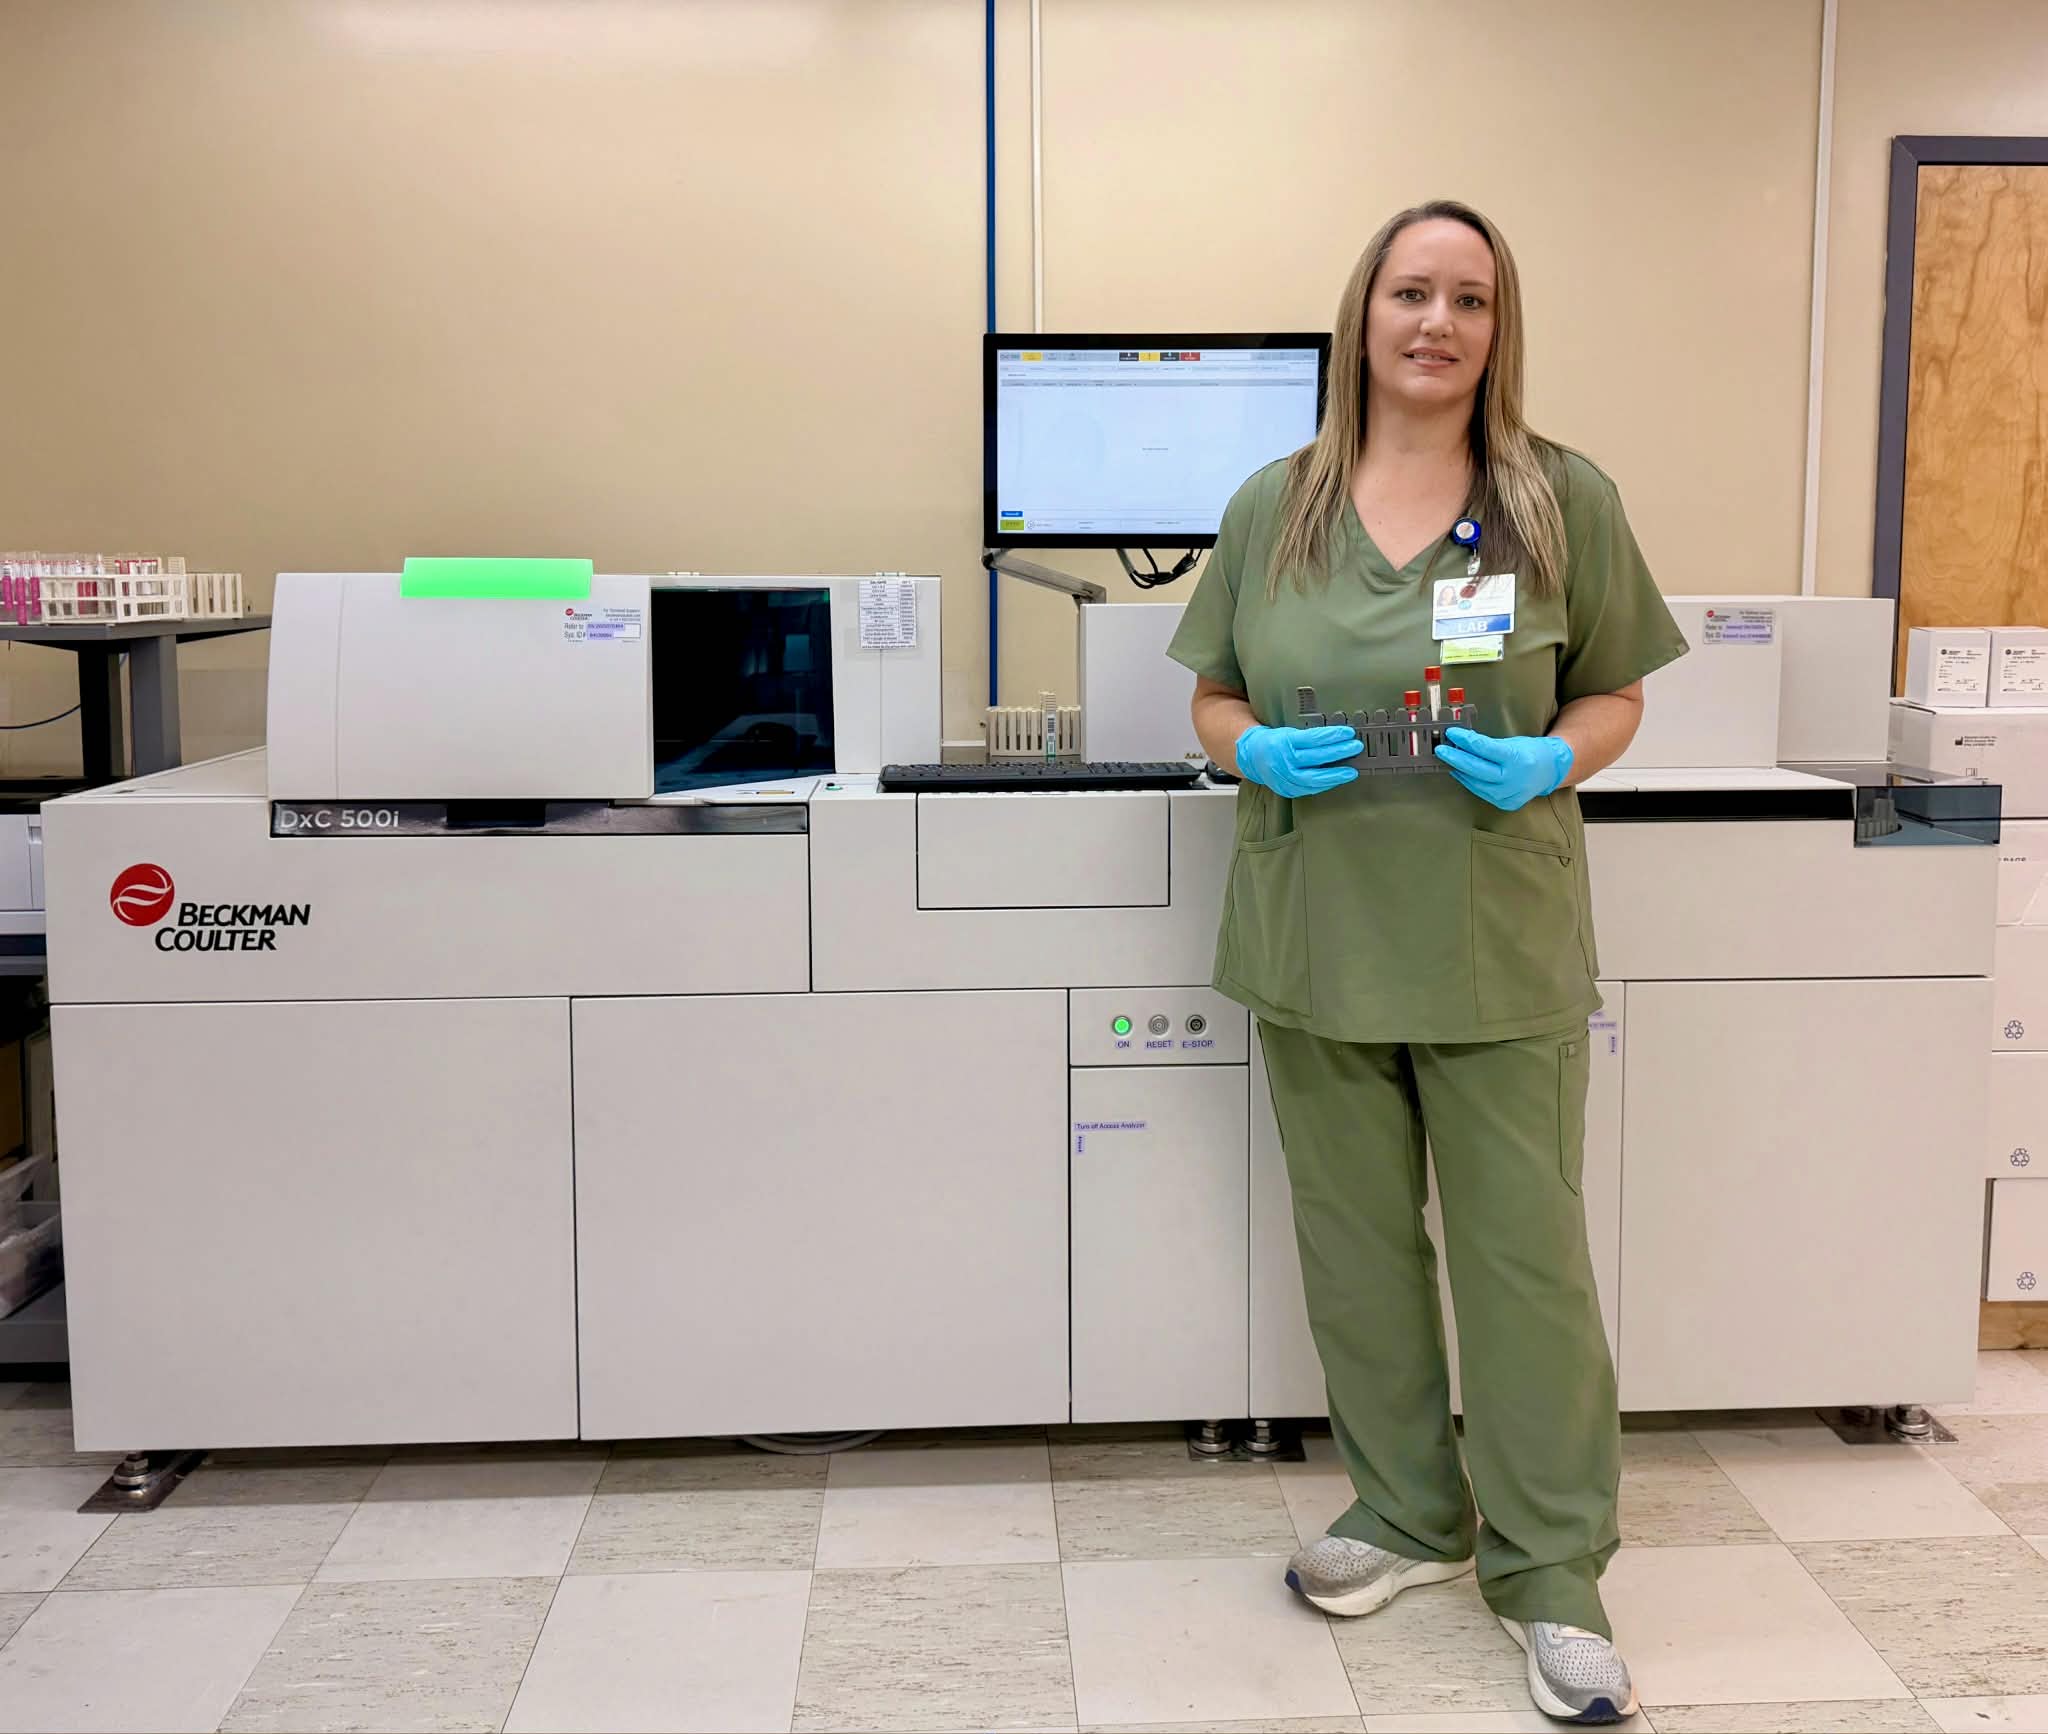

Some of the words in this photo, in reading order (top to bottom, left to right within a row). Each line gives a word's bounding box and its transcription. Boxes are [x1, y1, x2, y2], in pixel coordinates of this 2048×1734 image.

[1457, 621, 1488, 633] LAB
[280, 810, 332, 828] DxC
[340, 810, 399, 828] 500i
[177, 902, 311, 926] BECKMAN
[155, 927, 277, 951] COULTER
[1146, 1040, 1172, 1048] RESET
[1182, 1040, 1213, 1048] E-STOP
